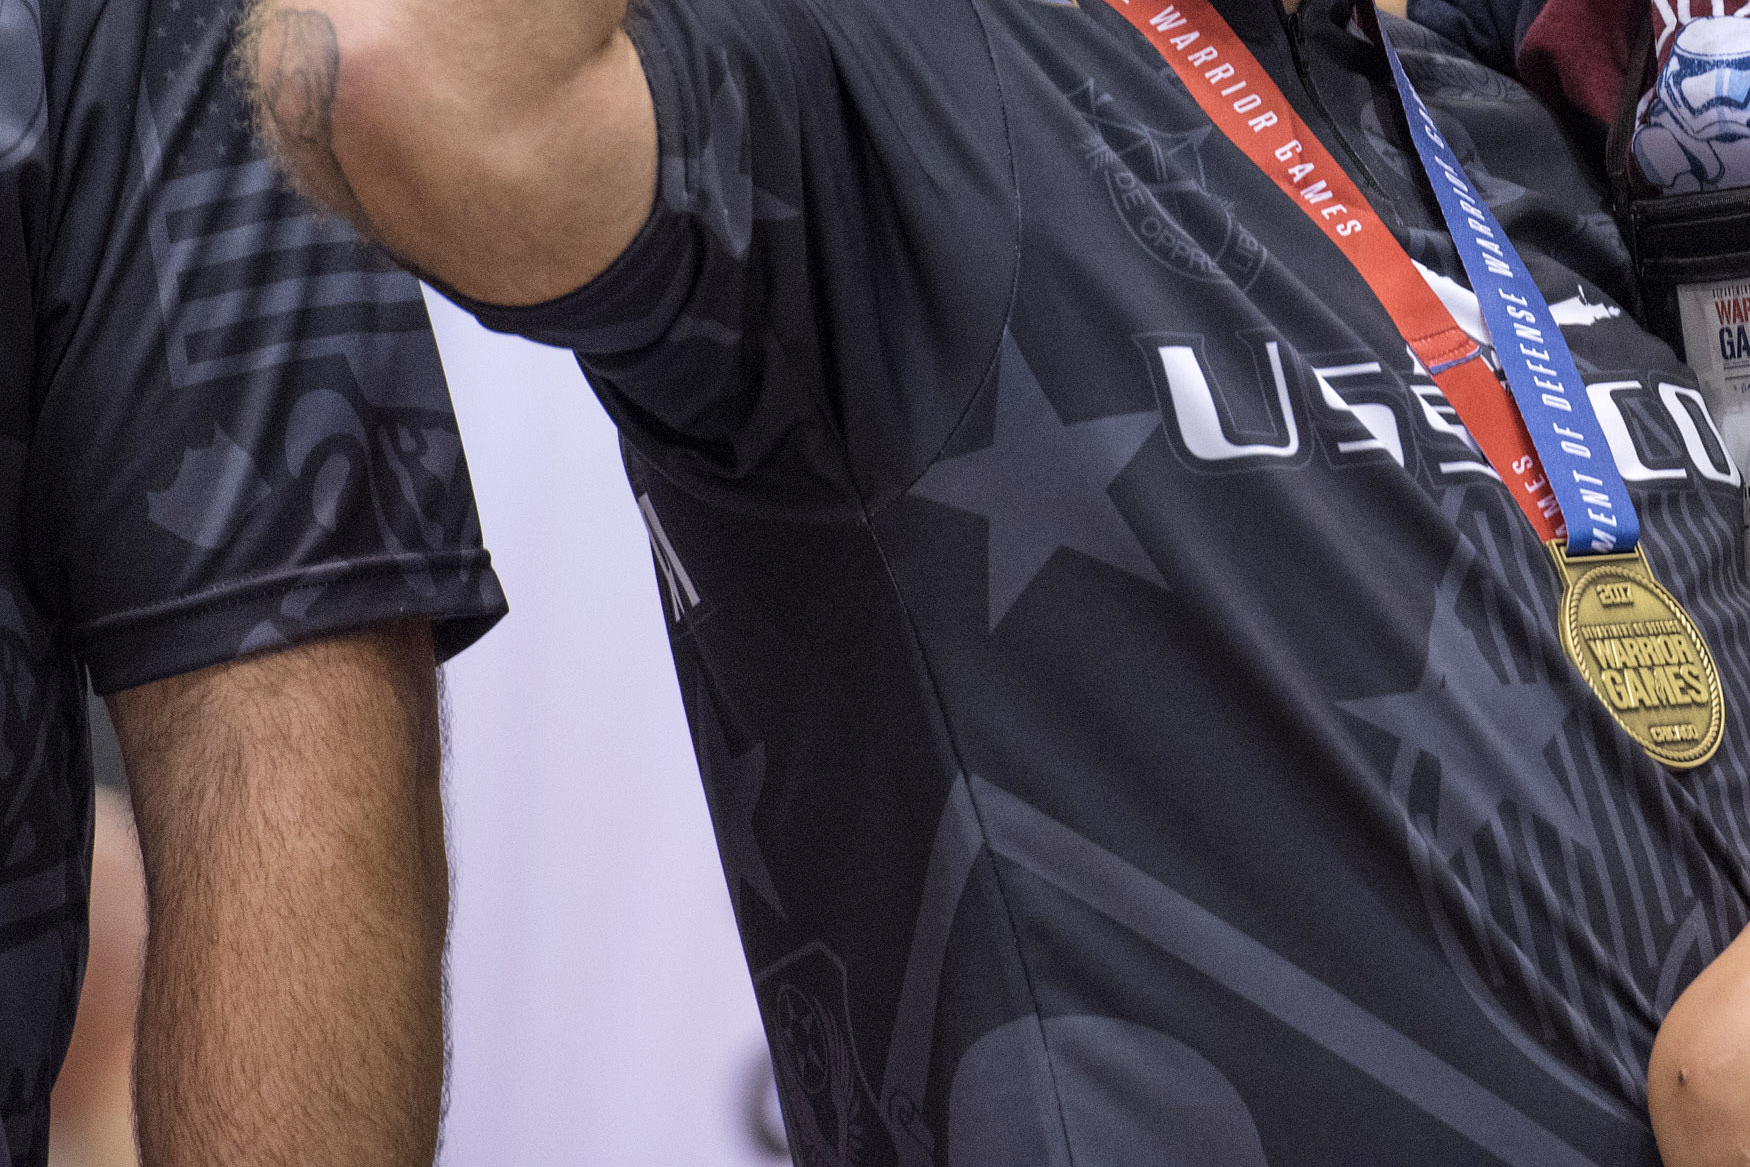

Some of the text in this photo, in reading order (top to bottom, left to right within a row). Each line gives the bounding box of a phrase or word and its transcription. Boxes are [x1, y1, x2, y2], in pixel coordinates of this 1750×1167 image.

[1149, 5, 1278, 132] WARRIOR
[1275, 140, 1362, 236] GAMES
[1499, 288, 1571, 412] DEFENSE
[1553, 422, 1591, 459] OF
[1597, 584, 1634, 607] 2017
[1588, 634, 1694, 670] WARRIOR
[1600, 664, 1708, 710] GAMES
